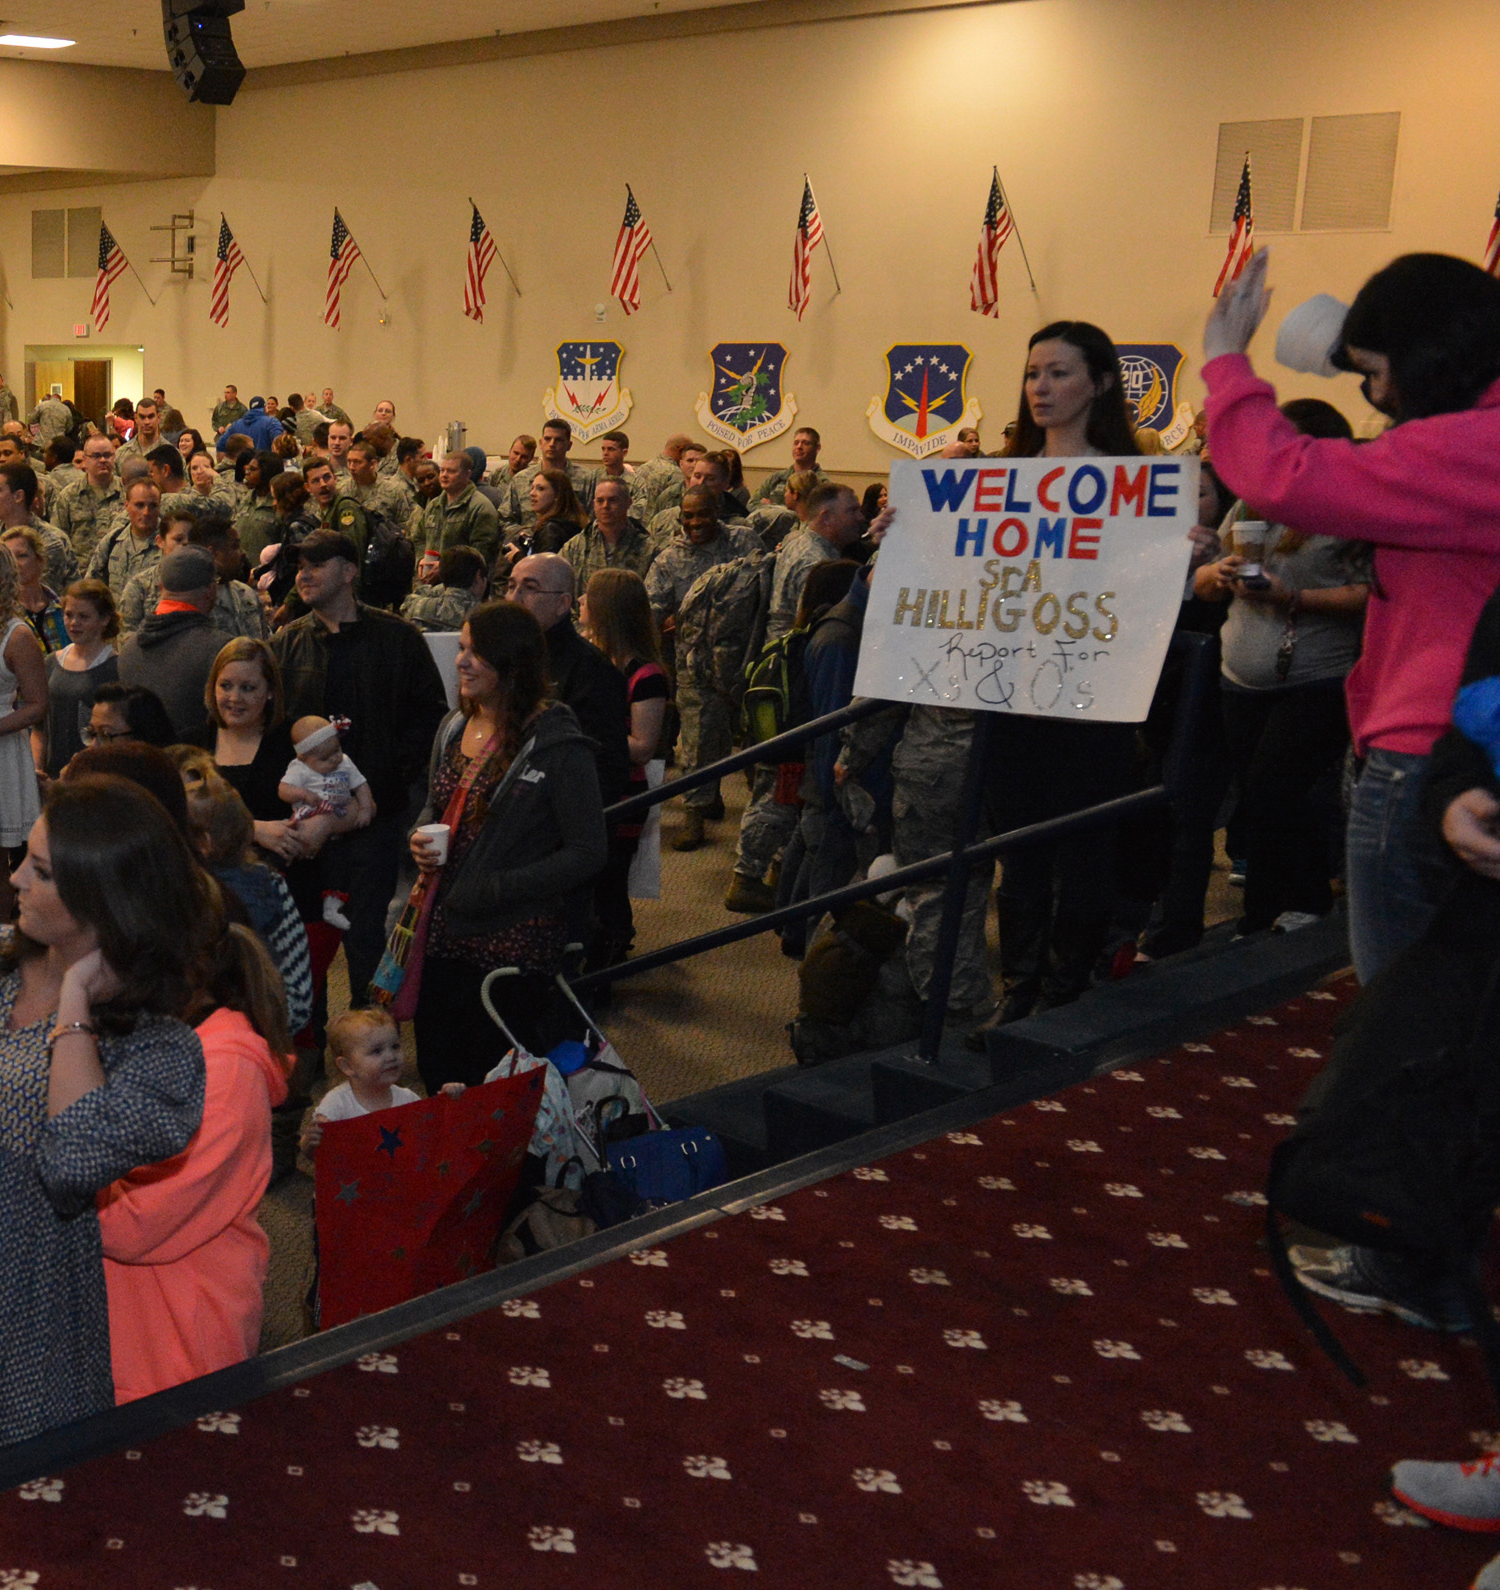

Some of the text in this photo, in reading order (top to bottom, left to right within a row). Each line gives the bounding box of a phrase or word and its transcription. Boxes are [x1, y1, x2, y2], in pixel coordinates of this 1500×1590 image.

[706, 419, 786, 448] POISED FOR PEACE
[892, 431, 948, 455] IMPAVIDE
[921, 464, 1181, 517] WELCOME
[955, 517, 1104, 560] HOME
[893, 587, 1119, 642] HILLIGOSS
[938, 633, 1110, 680] Report For
[975, 660, 1014, 709] &
